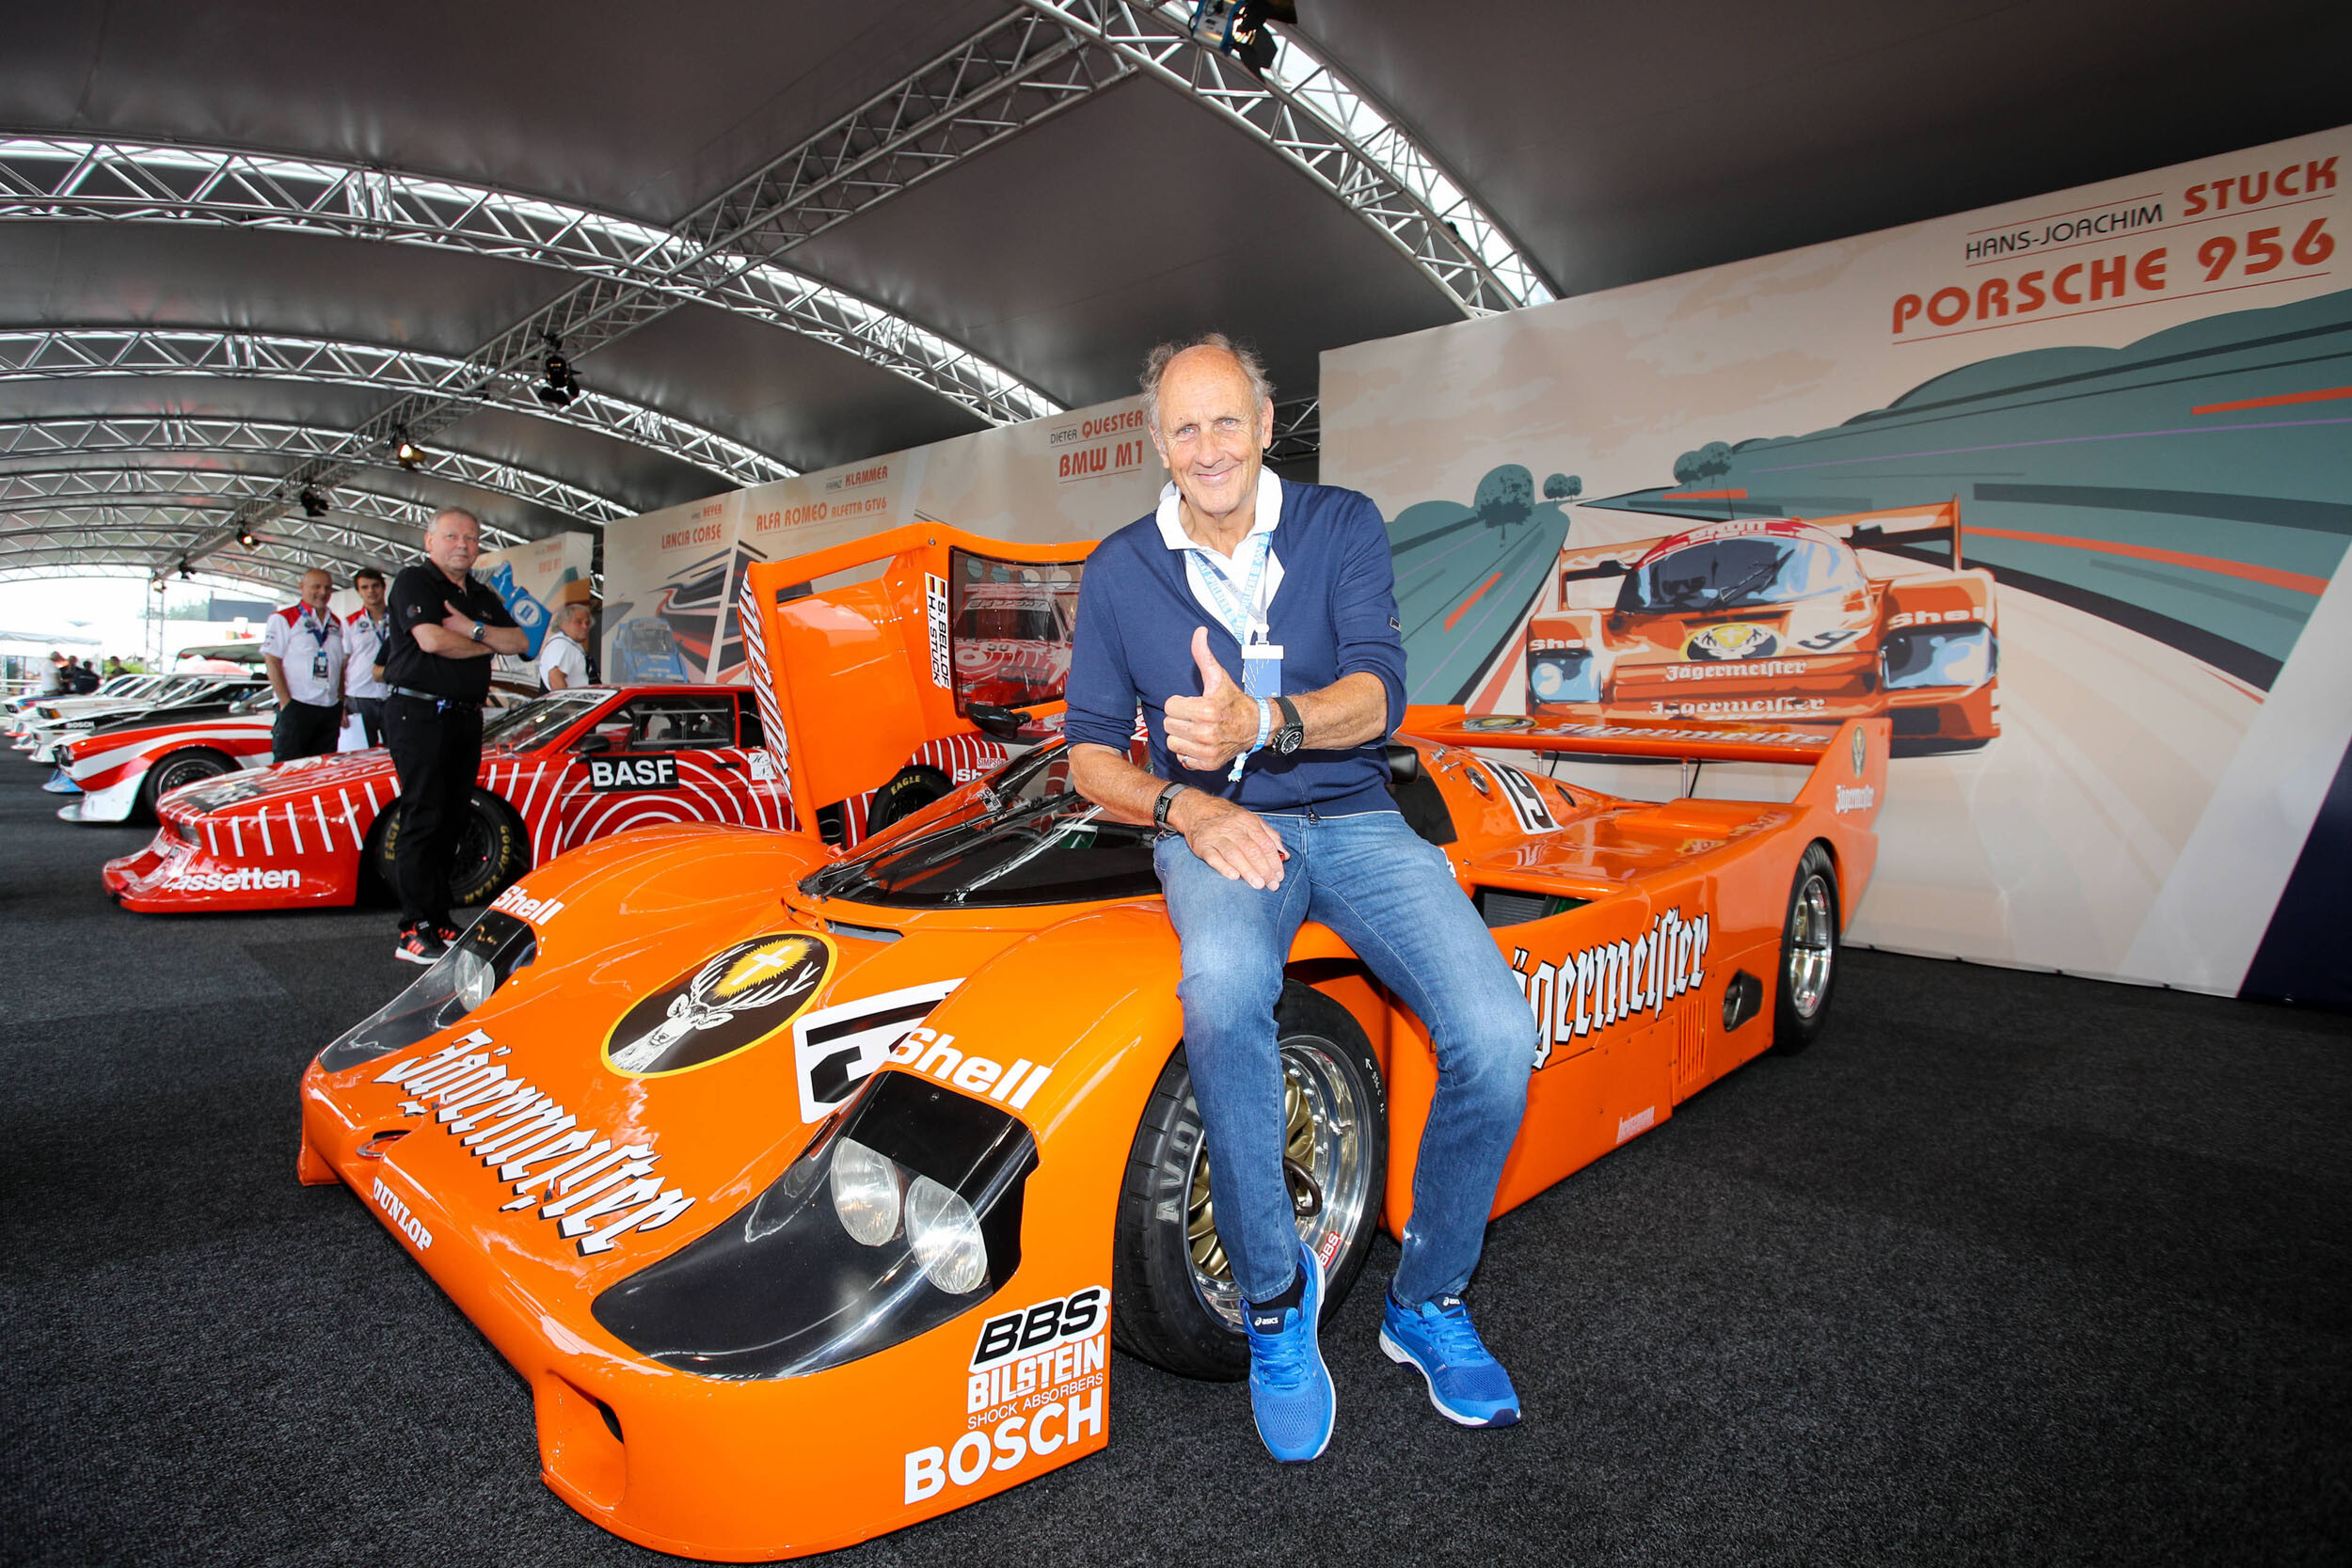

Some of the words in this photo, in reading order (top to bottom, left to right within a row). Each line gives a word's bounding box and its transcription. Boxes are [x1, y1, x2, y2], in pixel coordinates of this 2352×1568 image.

[1965, 203, 2163, 261] HANS-JOACHIM
[2183, 155, 2340, 217] STUCK
[1892, 247, 2167, 334] PORSCHE
[2198, 217, 2335, 282] 956
[1050, 429, 1077, 444] DIETER
[1082, 410, 1144, 438] QUESTER
[845, 466, 888, 485] KLAMMER
[1059, 447, 1107, 478] BMW
[1115, 440, 1143, 467] M1
[755, 512, 781, 531] ALFA
[785, 502, 827, 526] ROMEO
[831, 500, 863, 517] ALFETTA
[865, 497, 887, 513] GTV6
[661, 531, 691, 549] LANCIA
[937, 600, 946, 617] S.
[1887, 607, 1984, 630] Shel
[930, 627, 941, 685] STUCK
[938, 620, 950, 689] BELLOF
[1665, 660, 1808, 682] Jägermeister
[1535, 722, 1833, 746] Jägermeiste
[591, 759, 675, 787] BASF
[890, 774, 921, 796] EAGLE
[1481, 760, 1555, 830] 19
[384, 812, 401, 861] EAGL
[491, 885, 564, 927] Shell
[1511, 904, 1709, 1070] ägermeister
[889, 1027, 1053, 1111] Shell
[371, 1027, 698, 1258] Jägermeister
[373, 1176, 434, 1252] DUNLOP
[1319, 1232, 1340, 1267] BBS
[1261, 1317, 1279, 1326] asics
[1448, 1297, 1461, 1306] asics
[972, 1288, 1103, 1367] BBS
[967, 1334, 1105, 1415] BILSTEIN
[967, 1402, 1018, 1430] SHOCK
[1023, 1372, 1104, 1411] ABSORBERS
[904, 1386, 1103, 1506] BOSCH
